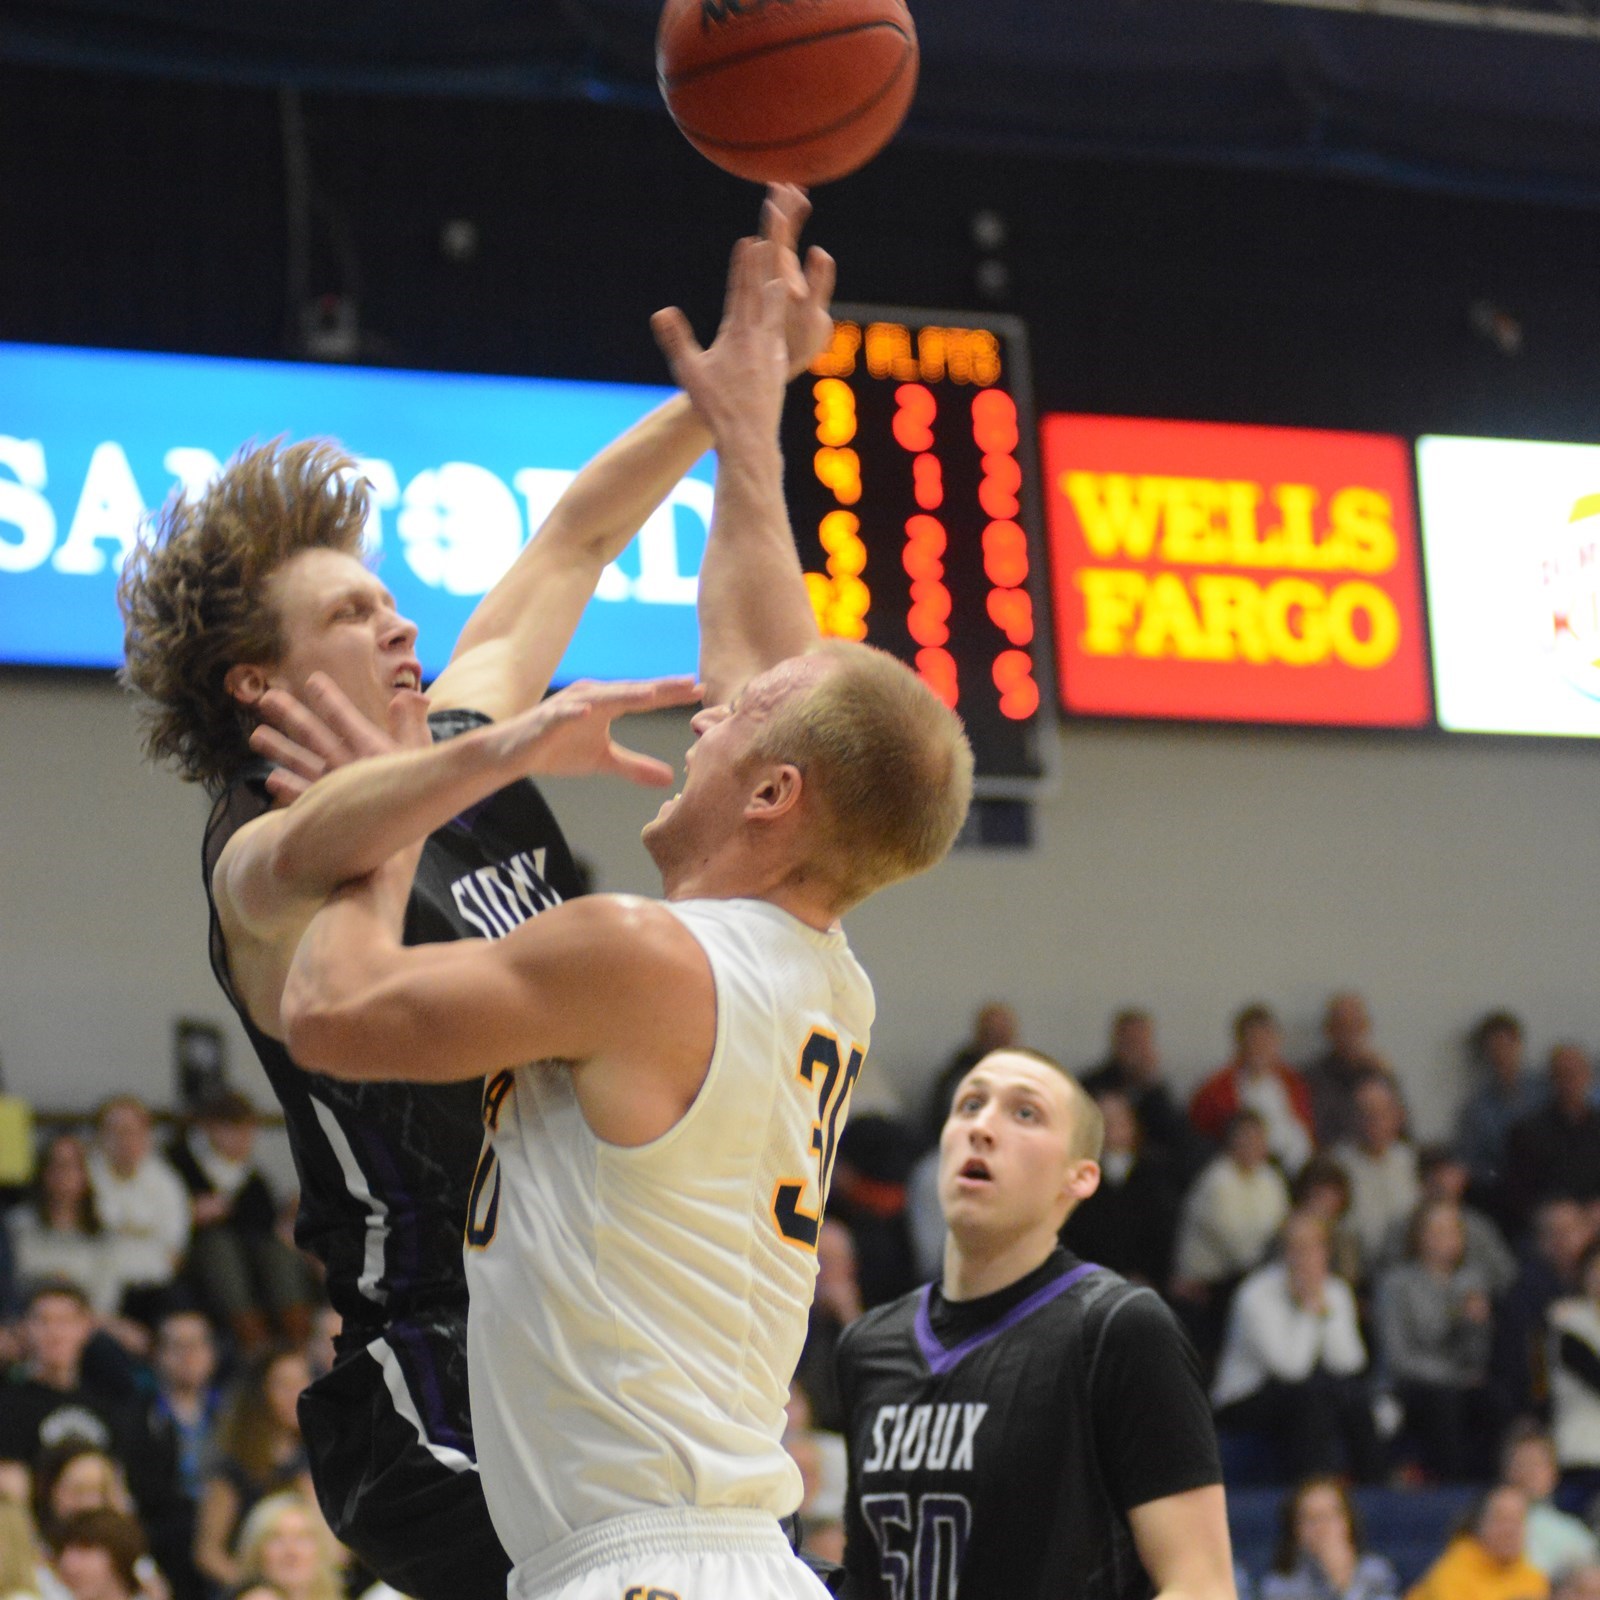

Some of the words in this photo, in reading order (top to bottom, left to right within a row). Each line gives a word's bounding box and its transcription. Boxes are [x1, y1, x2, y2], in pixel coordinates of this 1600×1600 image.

[0, 434, 716, 606] SAOD
[1060, 469, 1399, 574] WELLS
[1076, 567, 1400, 669] FARGO
[862, 1403, 988, 1473] SIOUX
[860, 1493, 972, 1600] 50
